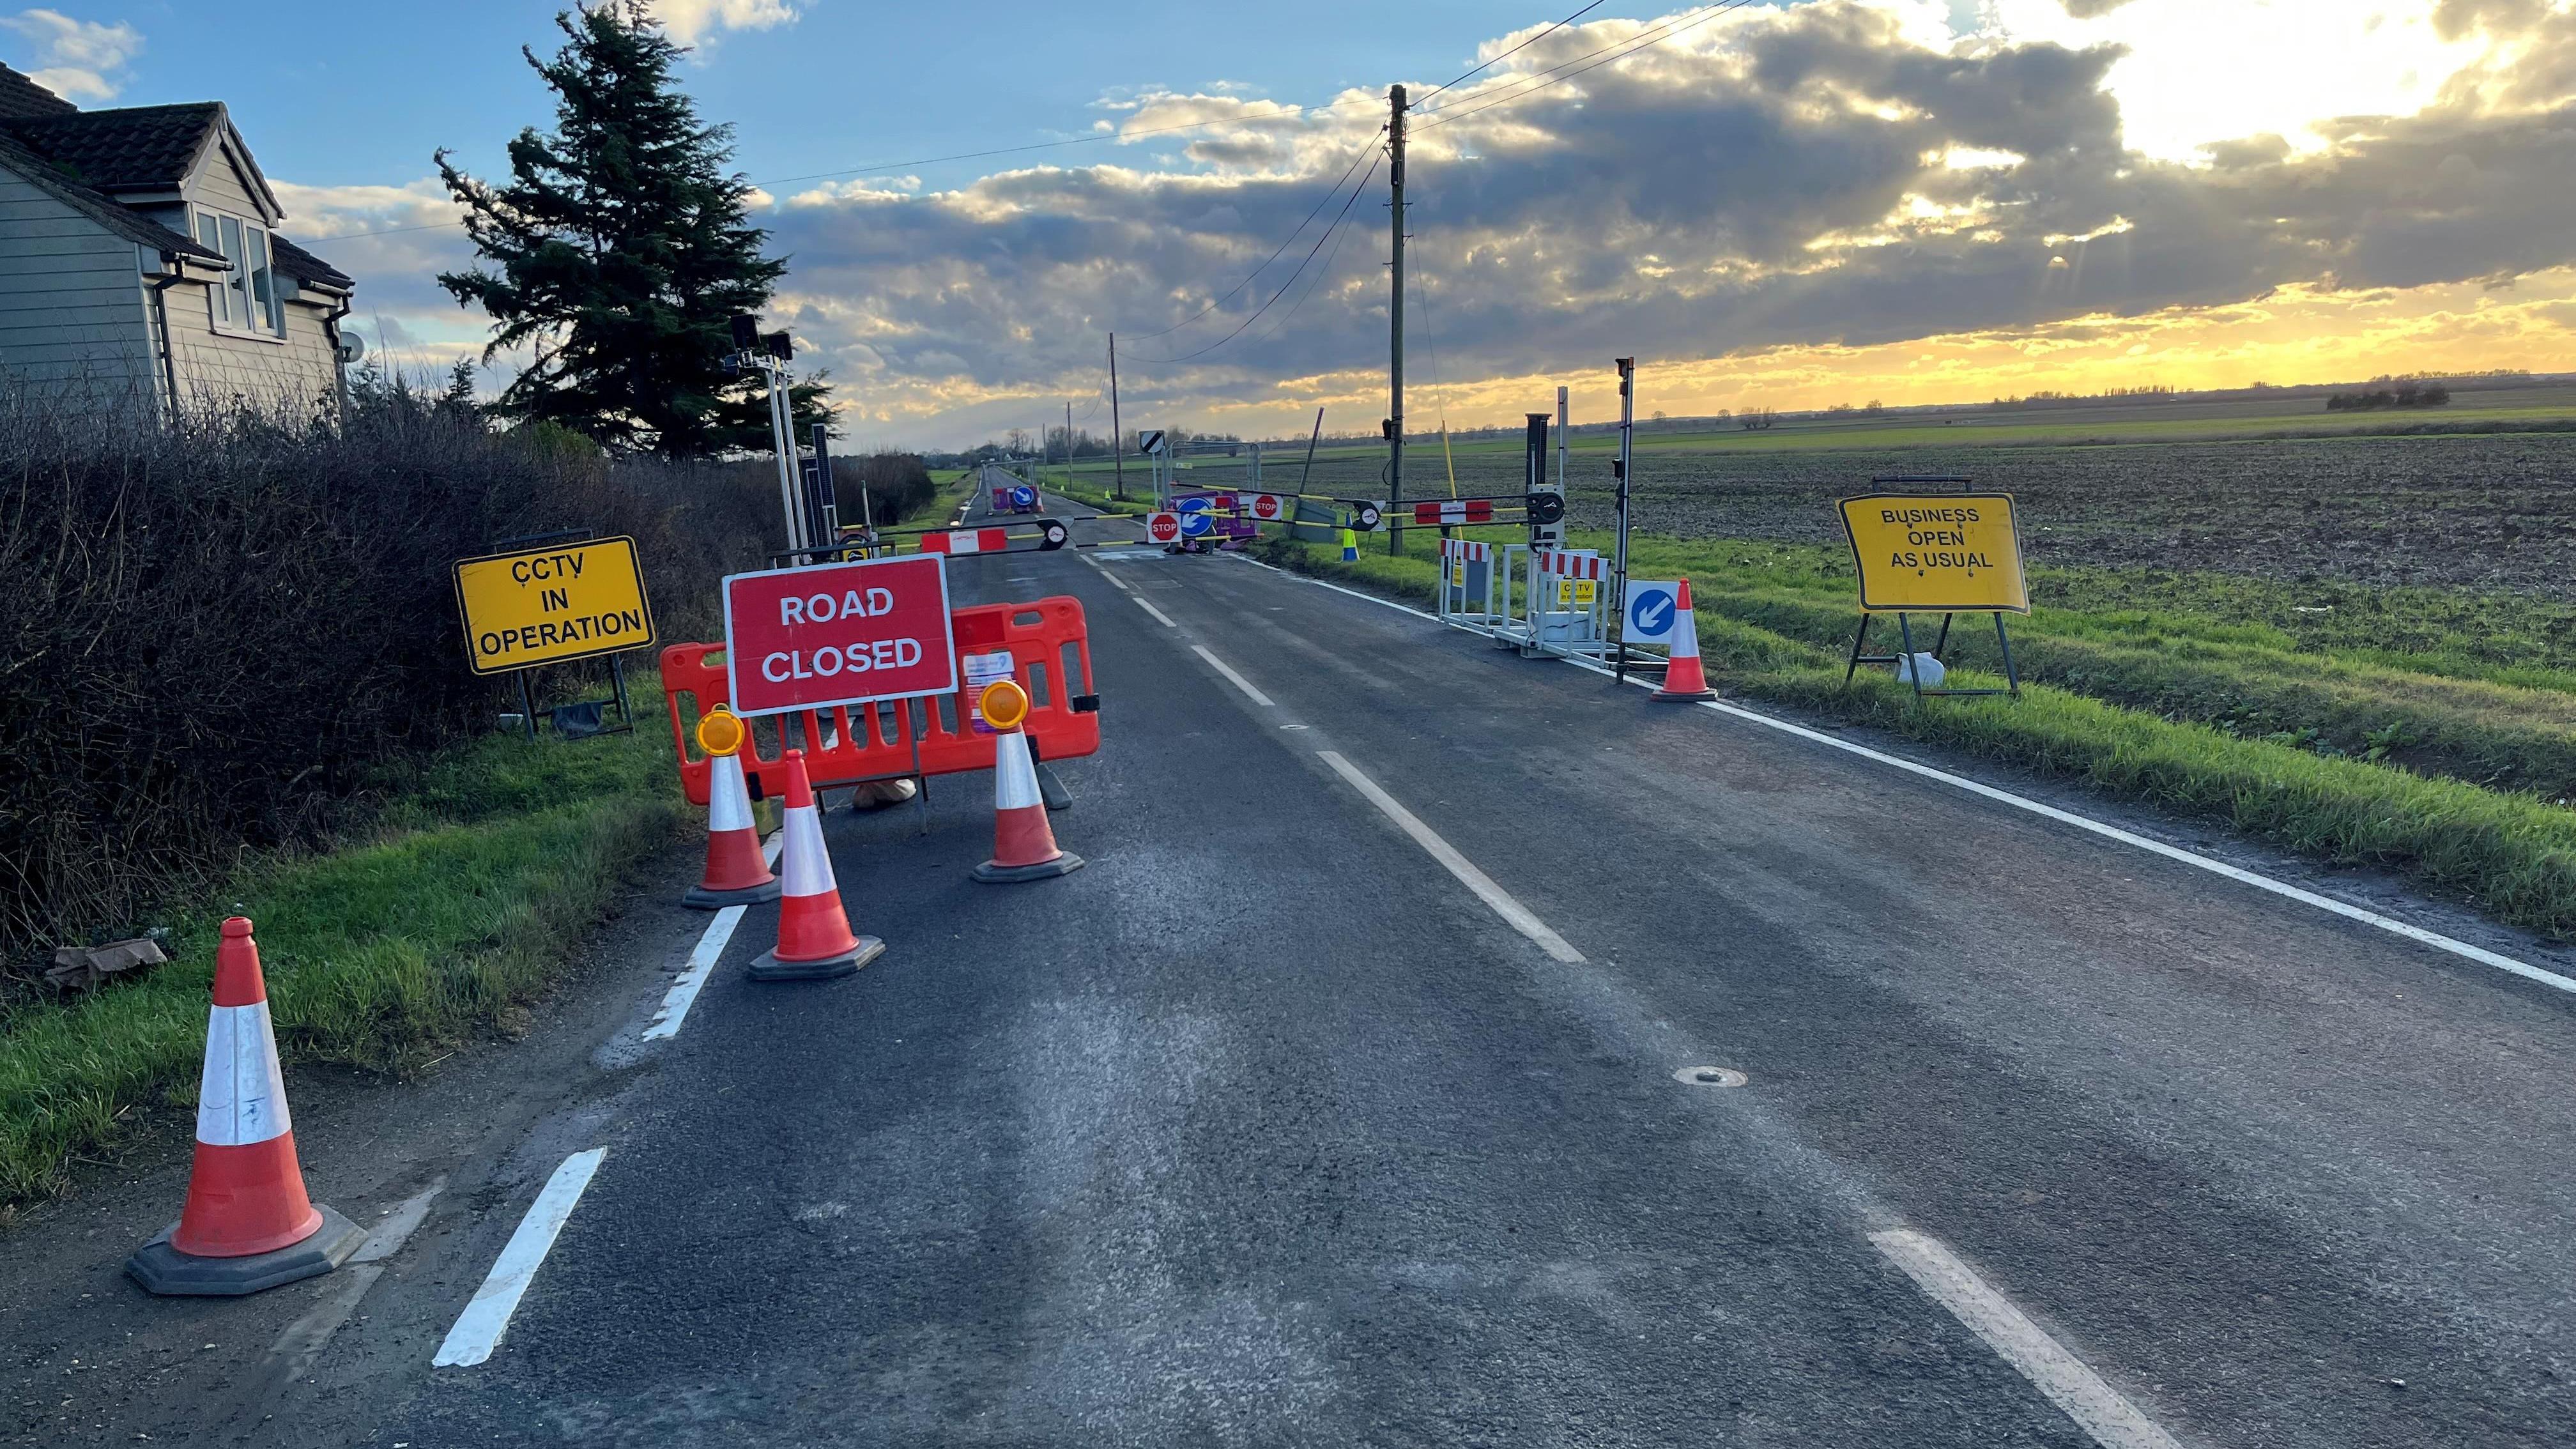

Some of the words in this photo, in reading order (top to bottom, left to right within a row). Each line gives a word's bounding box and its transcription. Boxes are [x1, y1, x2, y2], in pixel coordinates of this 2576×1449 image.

[1256, 502, 1276, 510] STOP
[1881, 509, 1979, 523] BUSINESS
[1153, 523, 1177, 532] STOP
[1908, 531, 1965, 546] OPEN
[512, 552, 583, 583] CCTV
[1891, 552, 1917, 567] AS
[1924, 552, 1993, 567] USUAL
[541, 588, 569, 612] IN
[781, 587, 894, 625] ROAD
[480, 609, 641, 656] OPERATION
[762, 638, 922, 682] CLOSED
